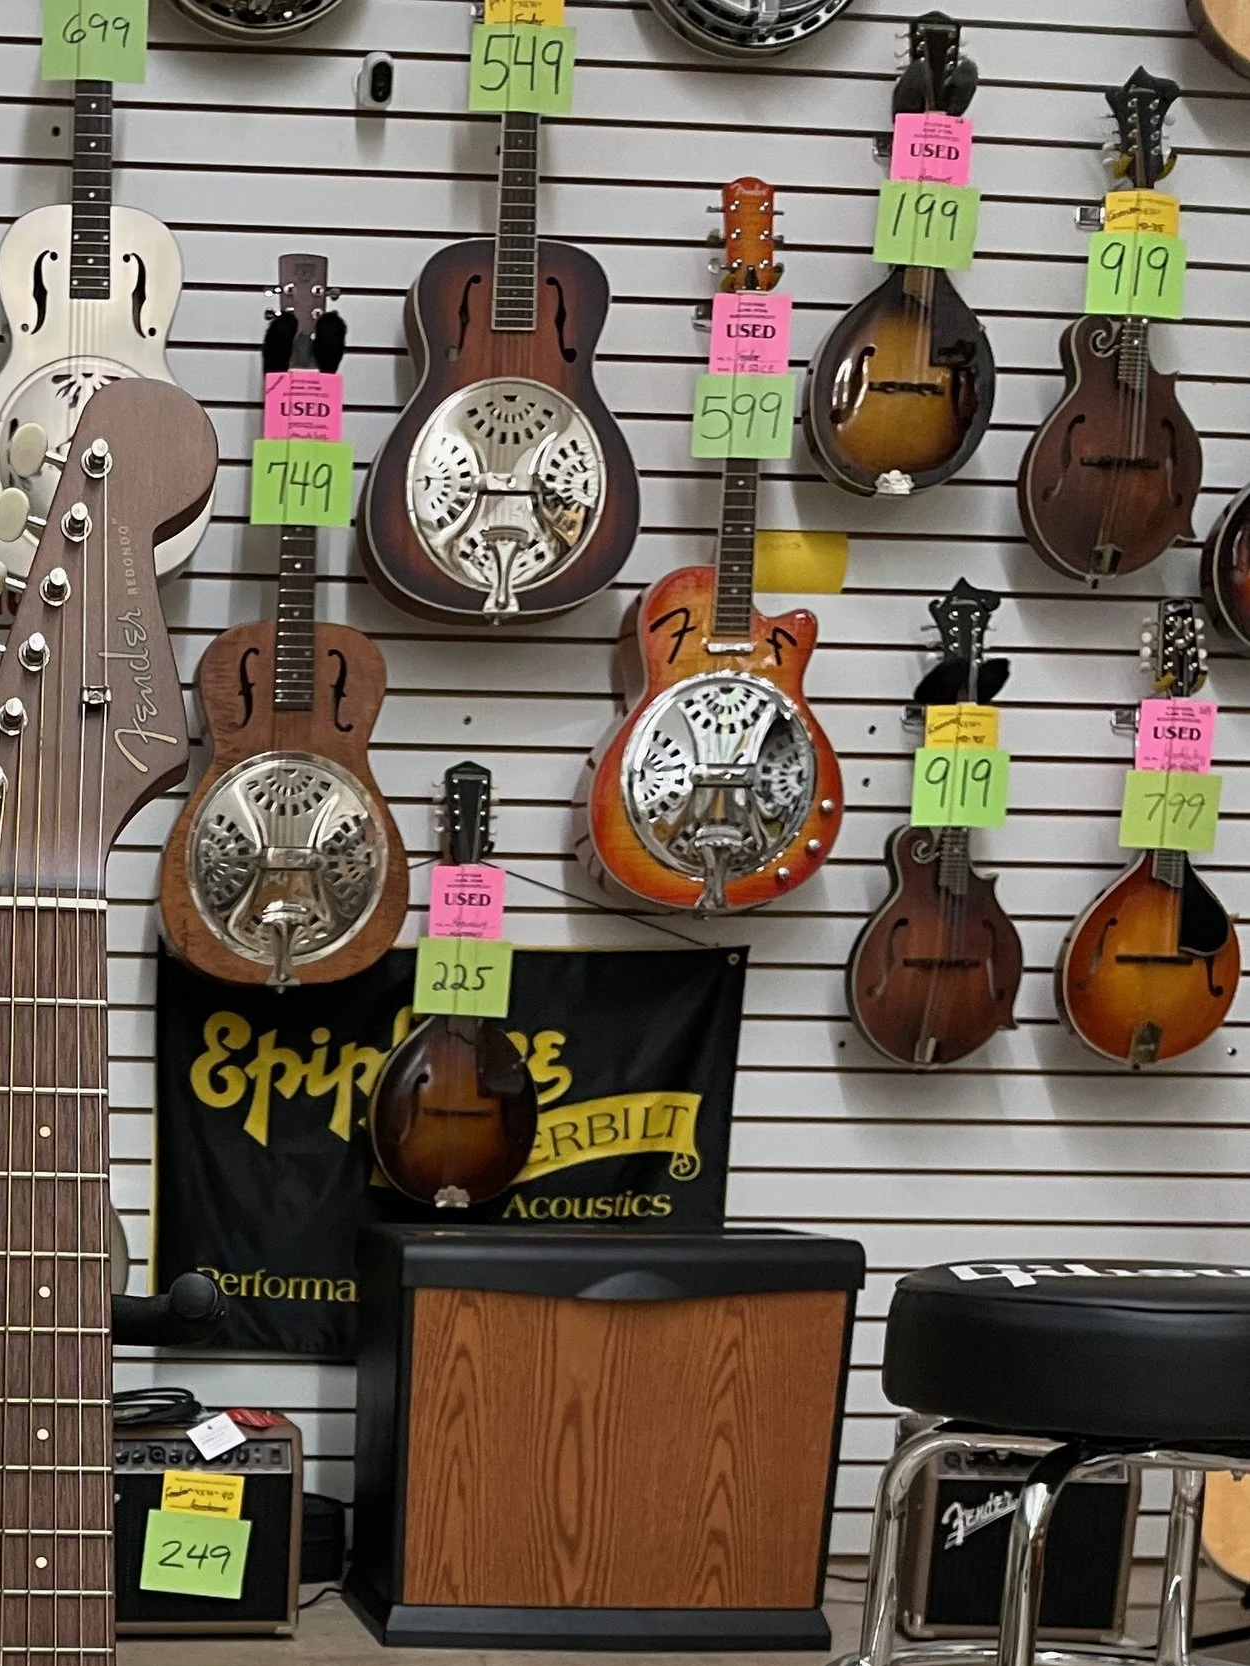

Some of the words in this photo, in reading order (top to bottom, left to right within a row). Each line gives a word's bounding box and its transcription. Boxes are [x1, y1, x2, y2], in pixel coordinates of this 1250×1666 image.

[62, 12, 130, 48] 699
[479, 34, 563, 95] 549
[910, 143, 960, 161] USED
[892, 192, 958, 241] 199
[1100, 242, 1168, 297] 919
[726, 323, 777, 340] USED
[280, 402, 331, 418] USED
[700, 391, 783, 439] 599
[267, 460, 333, 512] 749
[118, 524, 138, 596] REDONDO
[98, 606, 178, 774] Fender
[1153, 725, 1202, 742] USED
[925, 756, 992, 808] 919
[1144, 792, 1206, 830] 799
[444, 892, 492, 907] USED
[432, 961, 494, 991] 225
[190, 1010, 572, 1147] Epipe
[502, 1190, 673, 1220] Acoustics
[158, 1540, 232, 1575] 249
